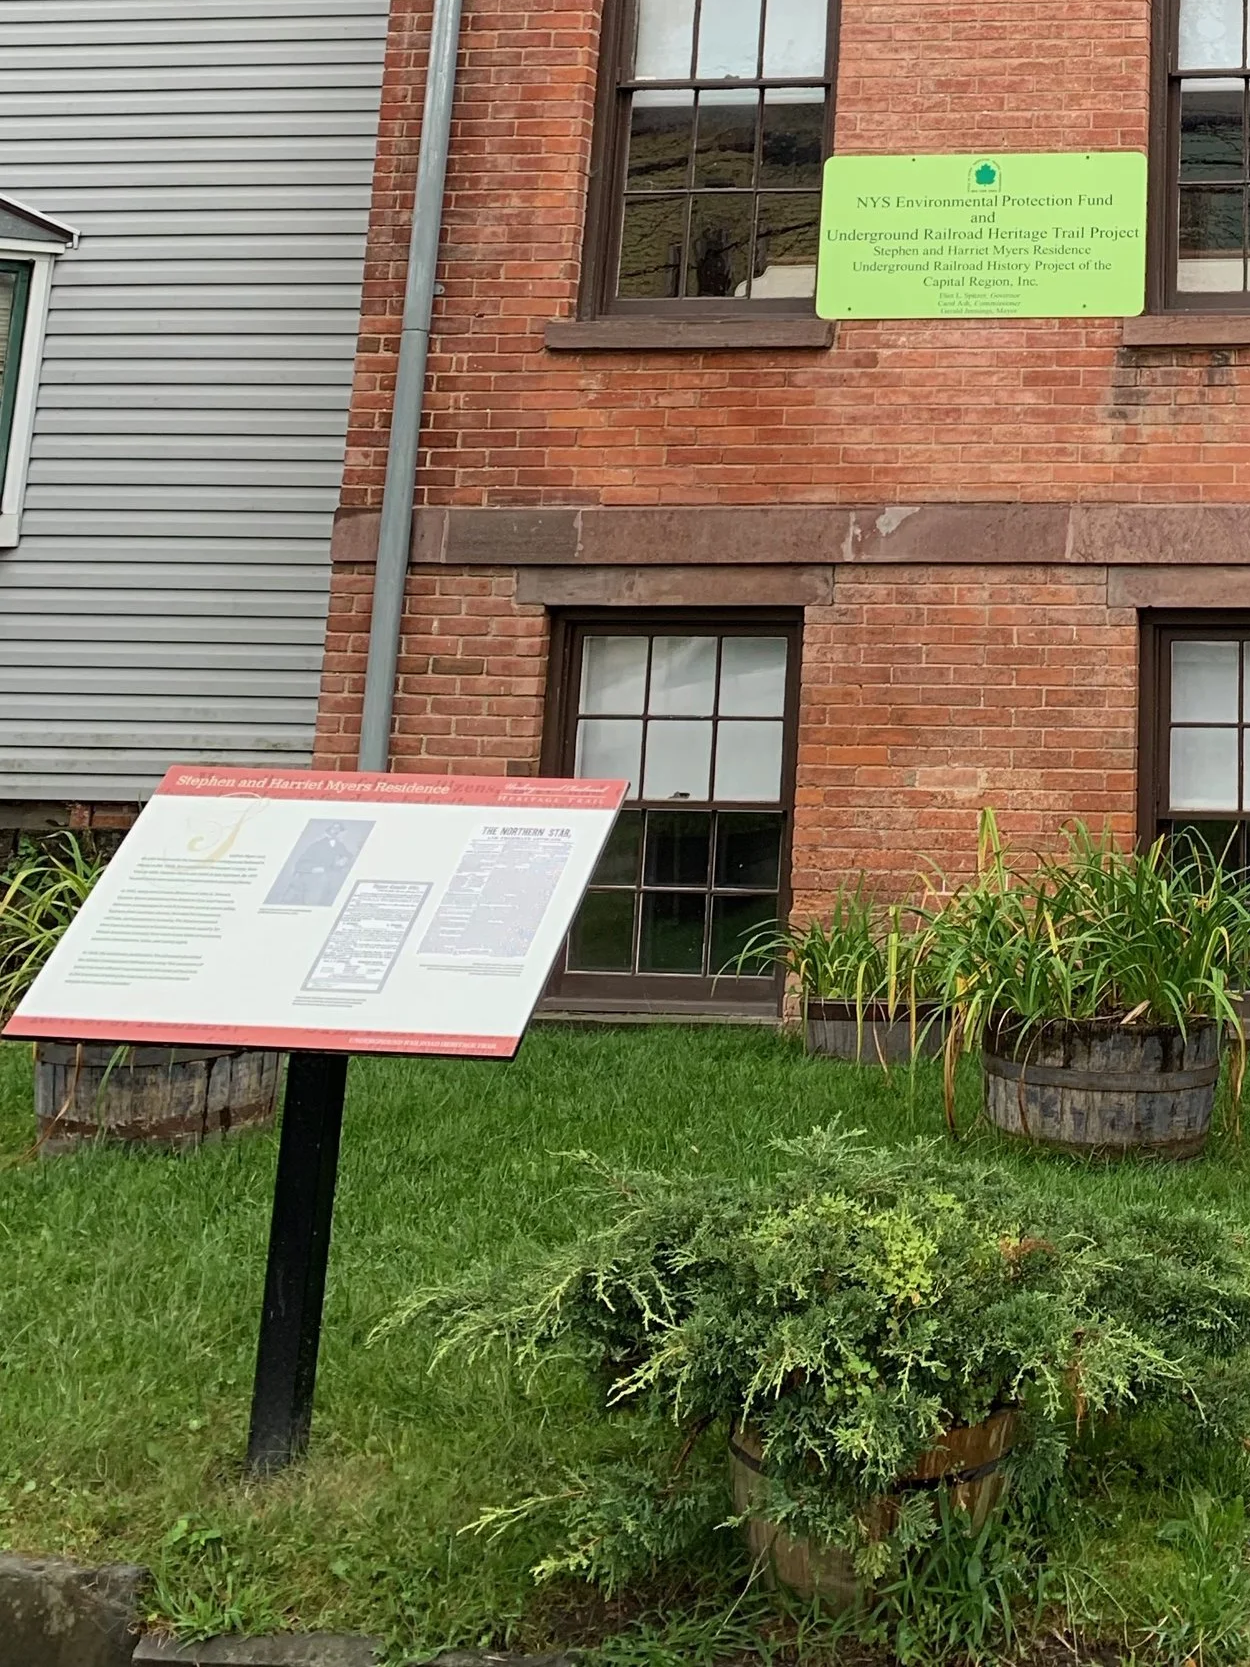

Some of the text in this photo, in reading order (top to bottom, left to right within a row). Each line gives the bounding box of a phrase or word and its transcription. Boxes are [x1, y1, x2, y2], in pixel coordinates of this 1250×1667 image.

[856, 194, 1113, 209] NYS Environmental Protection Fund
[970, 211, 995, 223] and
[827, 226, 1139, 244] Underground Railroad Heritage Trail Project
[873, 244, 1092, 259] Stephen and Harriet Myers Residence
[852, 259, 1112, 275] Underground Railroad History Project of the
[923, 276, 1039, 289] Capital Region, Inc.
[176, 775, 450, 795] Stephen and Harriet Myers Residence
[482, 826, 498, 835] THE
[500, 827, 545, 837] NORTHERN
